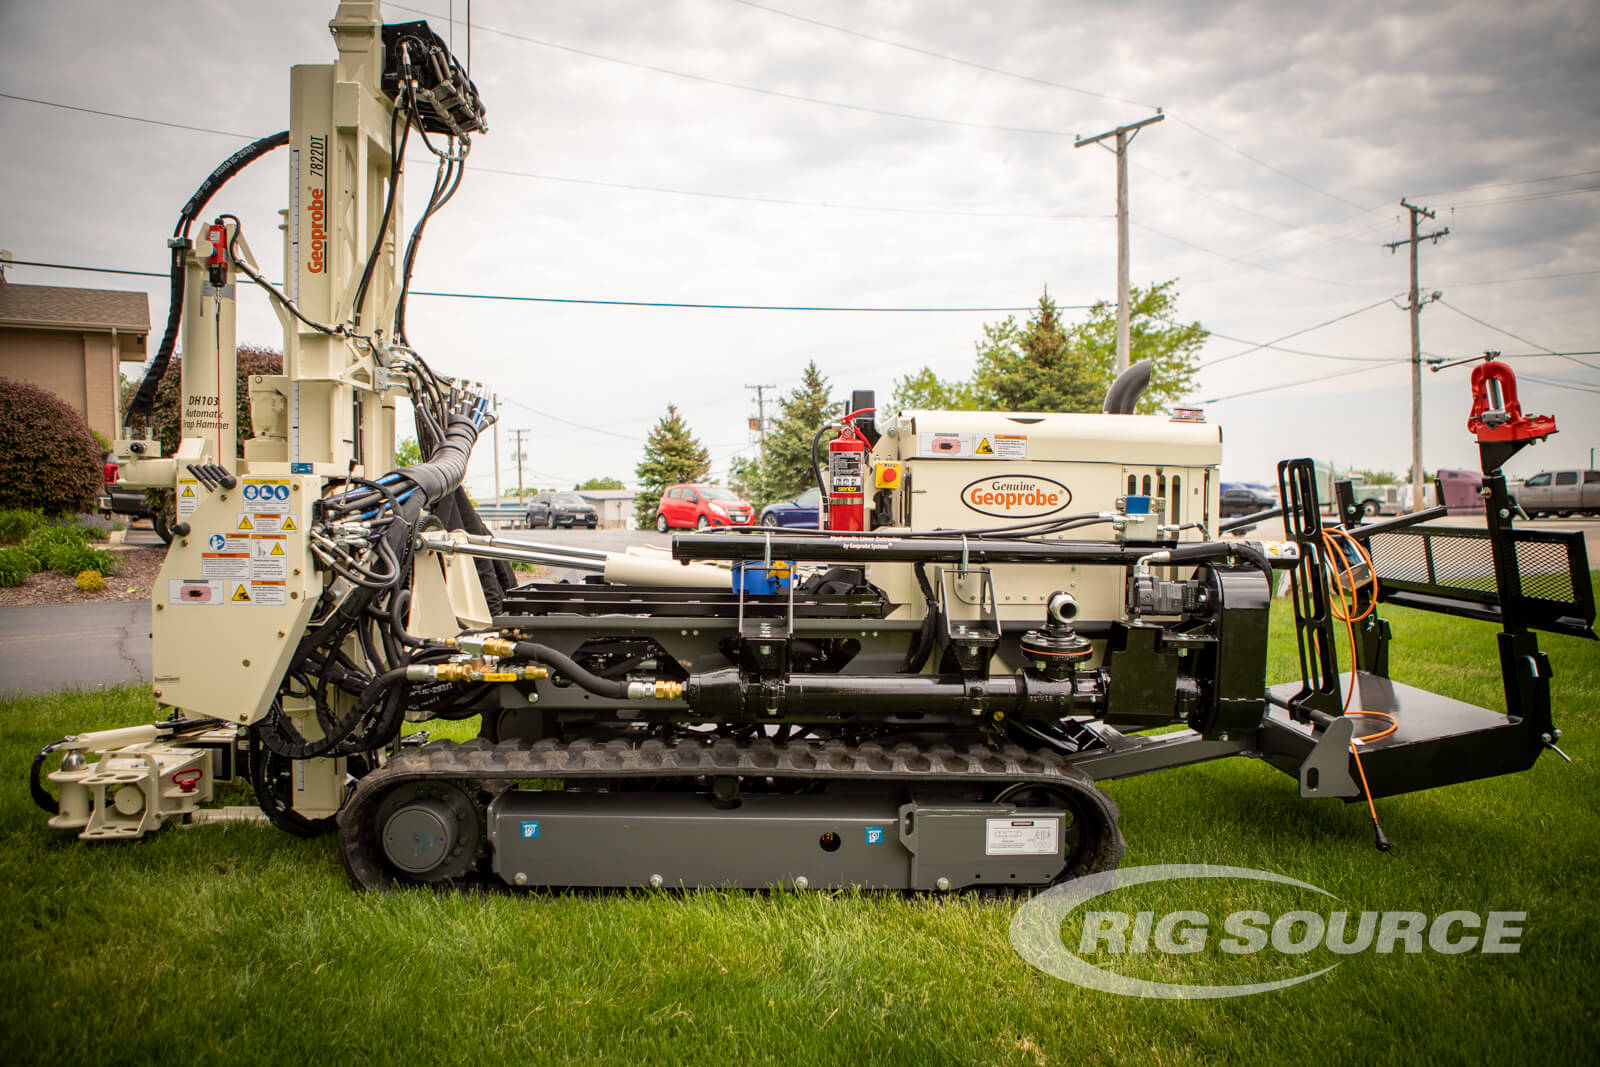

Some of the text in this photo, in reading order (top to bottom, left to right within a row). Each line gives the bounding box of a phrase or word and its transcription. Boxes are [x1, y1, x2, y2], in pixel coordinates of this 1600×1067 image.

[307, 135, 328, 274] Geoprobe 7822DT
[188, 395, 220, 406] DH103
[991, 481, 1036, 492] Genuine
[970, 488, 1059, 510] Geoprobe
